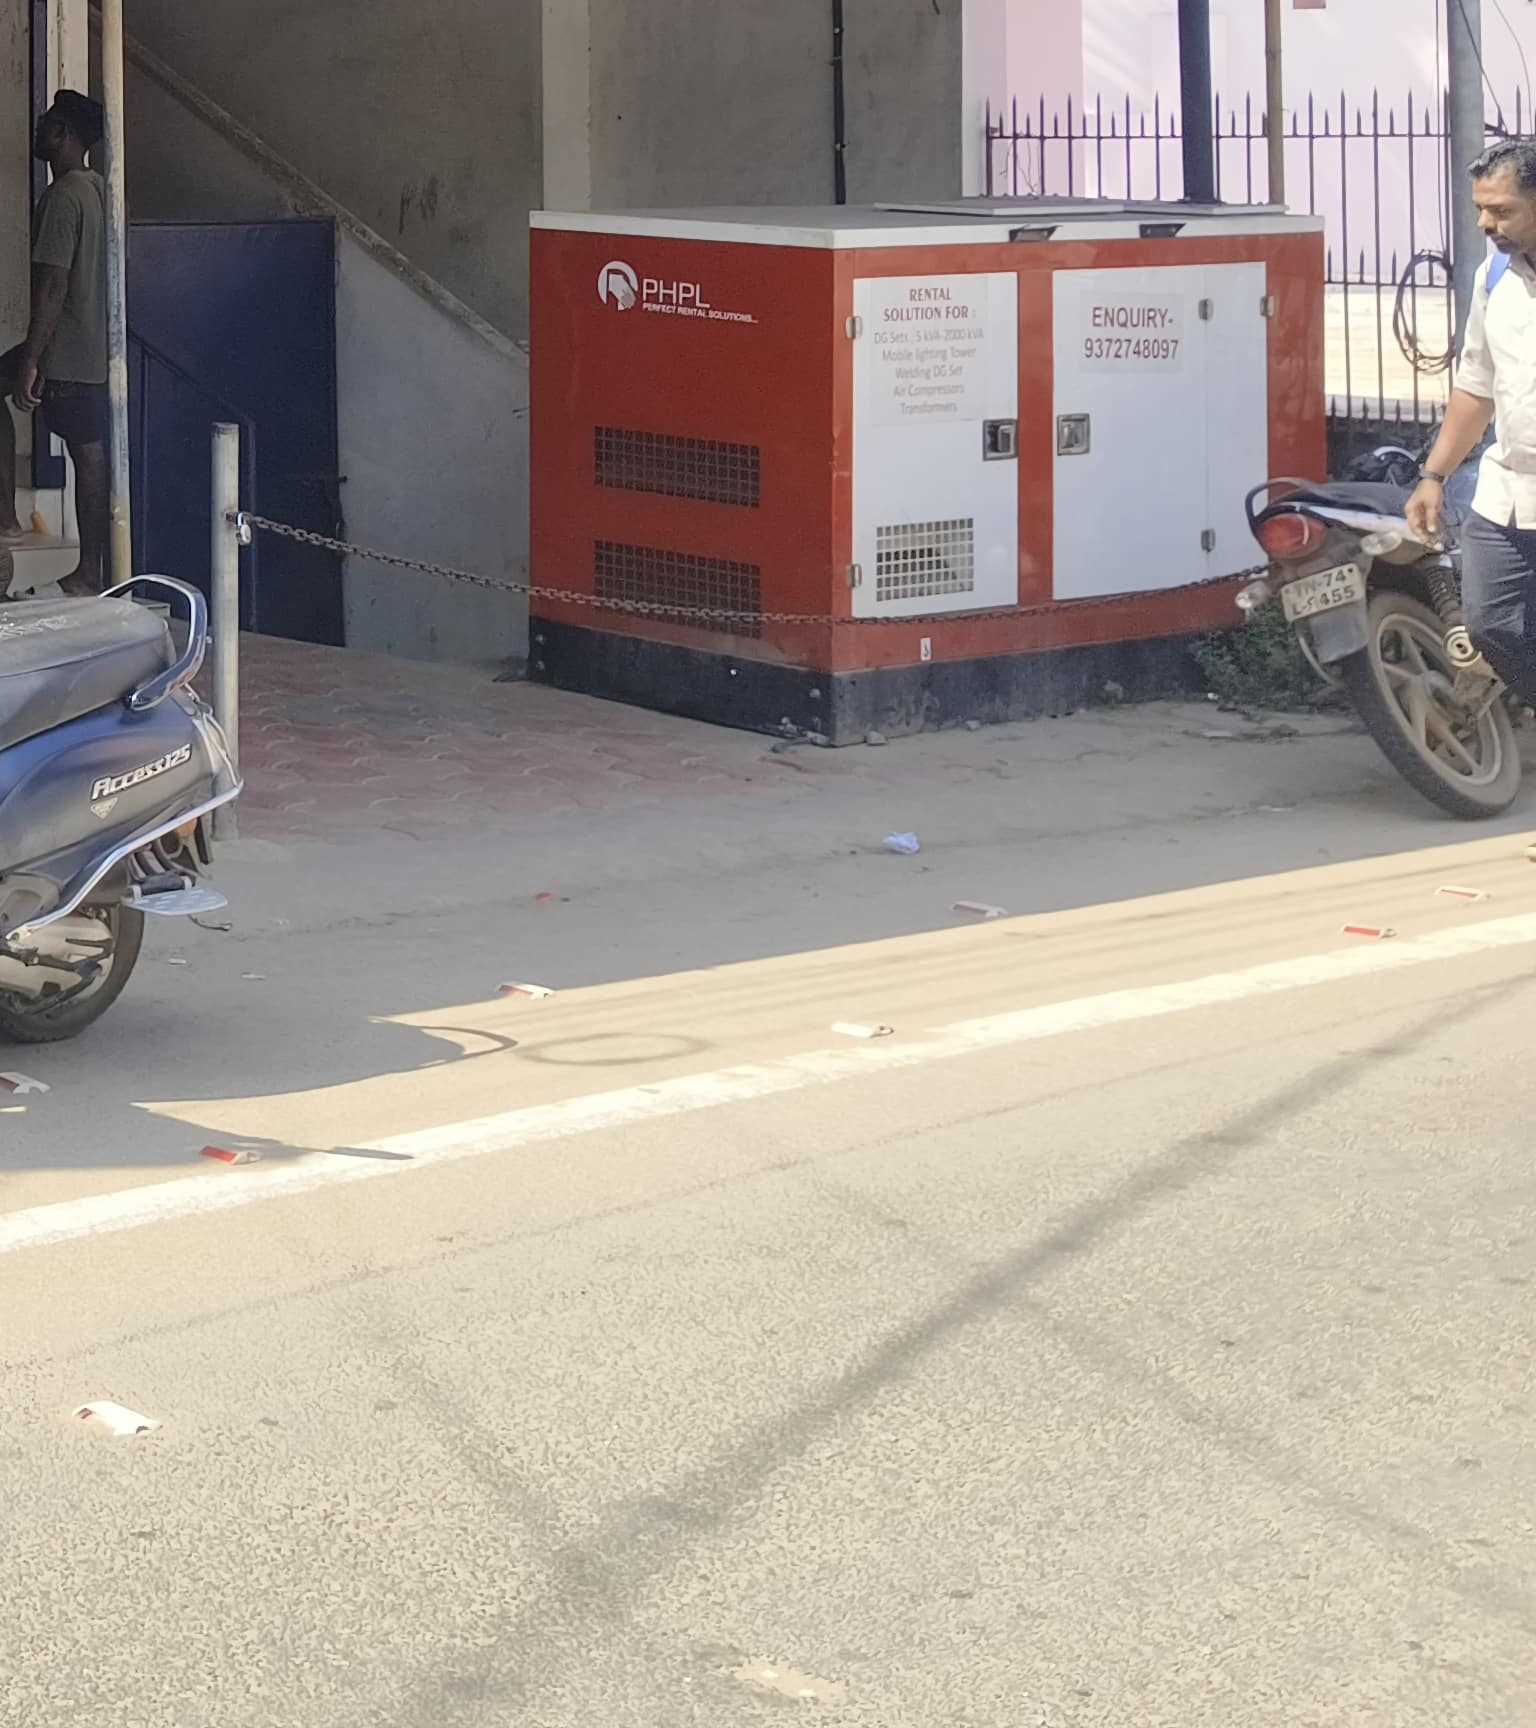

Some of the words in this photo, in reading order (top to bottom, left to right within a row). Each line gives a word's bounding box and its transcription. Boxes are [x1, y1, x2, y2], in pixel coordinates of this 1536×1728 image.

[642, 278, 710, 309] PHPL
[909, 288, 951, 302] RENTAL
[642, 302, 676, 315] PERFECT
[678, 307, 706, 319] RENTAL
[883, 306, 941, 322] SOLUTION
[945, 305, 969, 319] FOR
[1084, 338, 1179, 360] 9372748097
